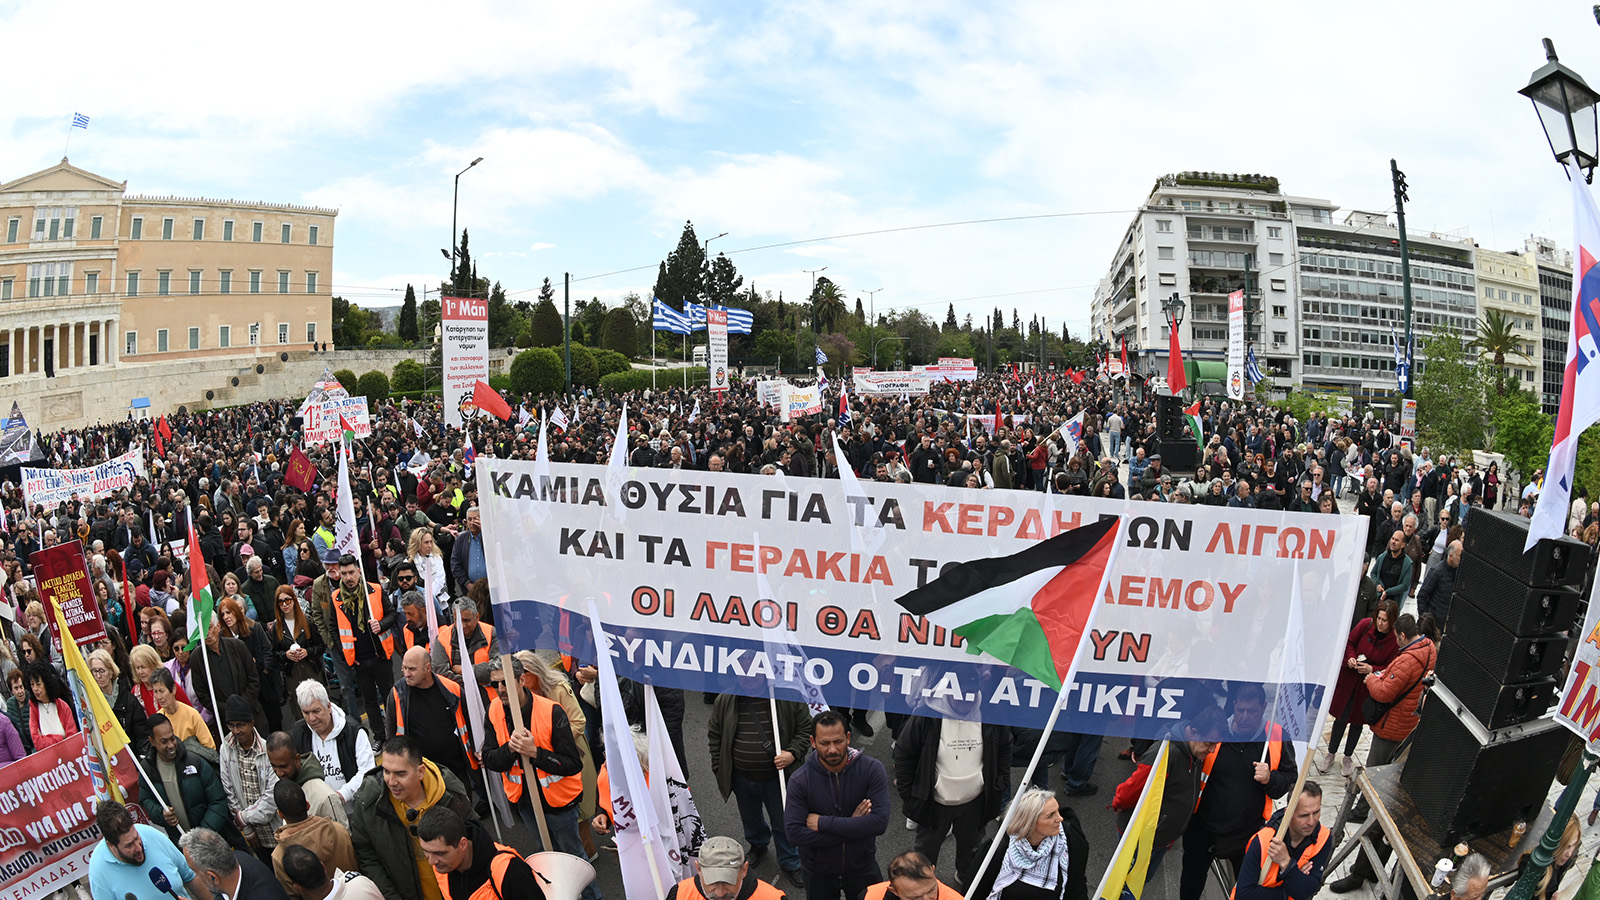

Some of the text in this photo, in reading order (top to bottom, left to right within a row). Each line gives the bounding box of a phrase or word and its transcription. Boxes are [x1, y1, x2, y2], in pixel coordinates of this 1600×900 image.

[459, 300, 486, 317] Μάη
[445, 325, 475, 334] Κατάργηση
[490, 471, 607, 507] ΚΑΜΙΑ
[620, 480, 747, 518] ΘΥΣΙΑ
[761, 489, 832, 525] ΓΙΑ
[846, 495, 907, 530] ΤΑ
[922, 501, 1082, 541] ΚΕΡΔΗ
[1205, 522, 1336, 560] ΛΙΓΩΝ
[558, 527, 625, 561] ΚΑΙ
[638, 534, 692, 567] ΤΑ
[705, 540, 894, 587] ΓΕΡΑΚΙΑ
[60, 597, 83, 611] ΡΓΑΝΩΣΗ
[84, 611, 97, 622] ΜΑΣ
[631, 585, 675, 618] ΟΙ
[690, 592, 798, 631] ΛΑΟΙ
[816, 605, 882, 640] ΘΑ
[605, 632, 834, 686] ΣΥΝΔΙΚΑΤΟ
[848, 663, 976, 702] Ο.Τ.Α.
[16, 758, 80, 808] εργατικής
[25, 814, 58, 844] για
[56, 801, 89, 834] μια
[44, 823, 100, 857] ανισοτιμ
[13, 861, 79, 900] ΕΛΛΑΔΑΣ
